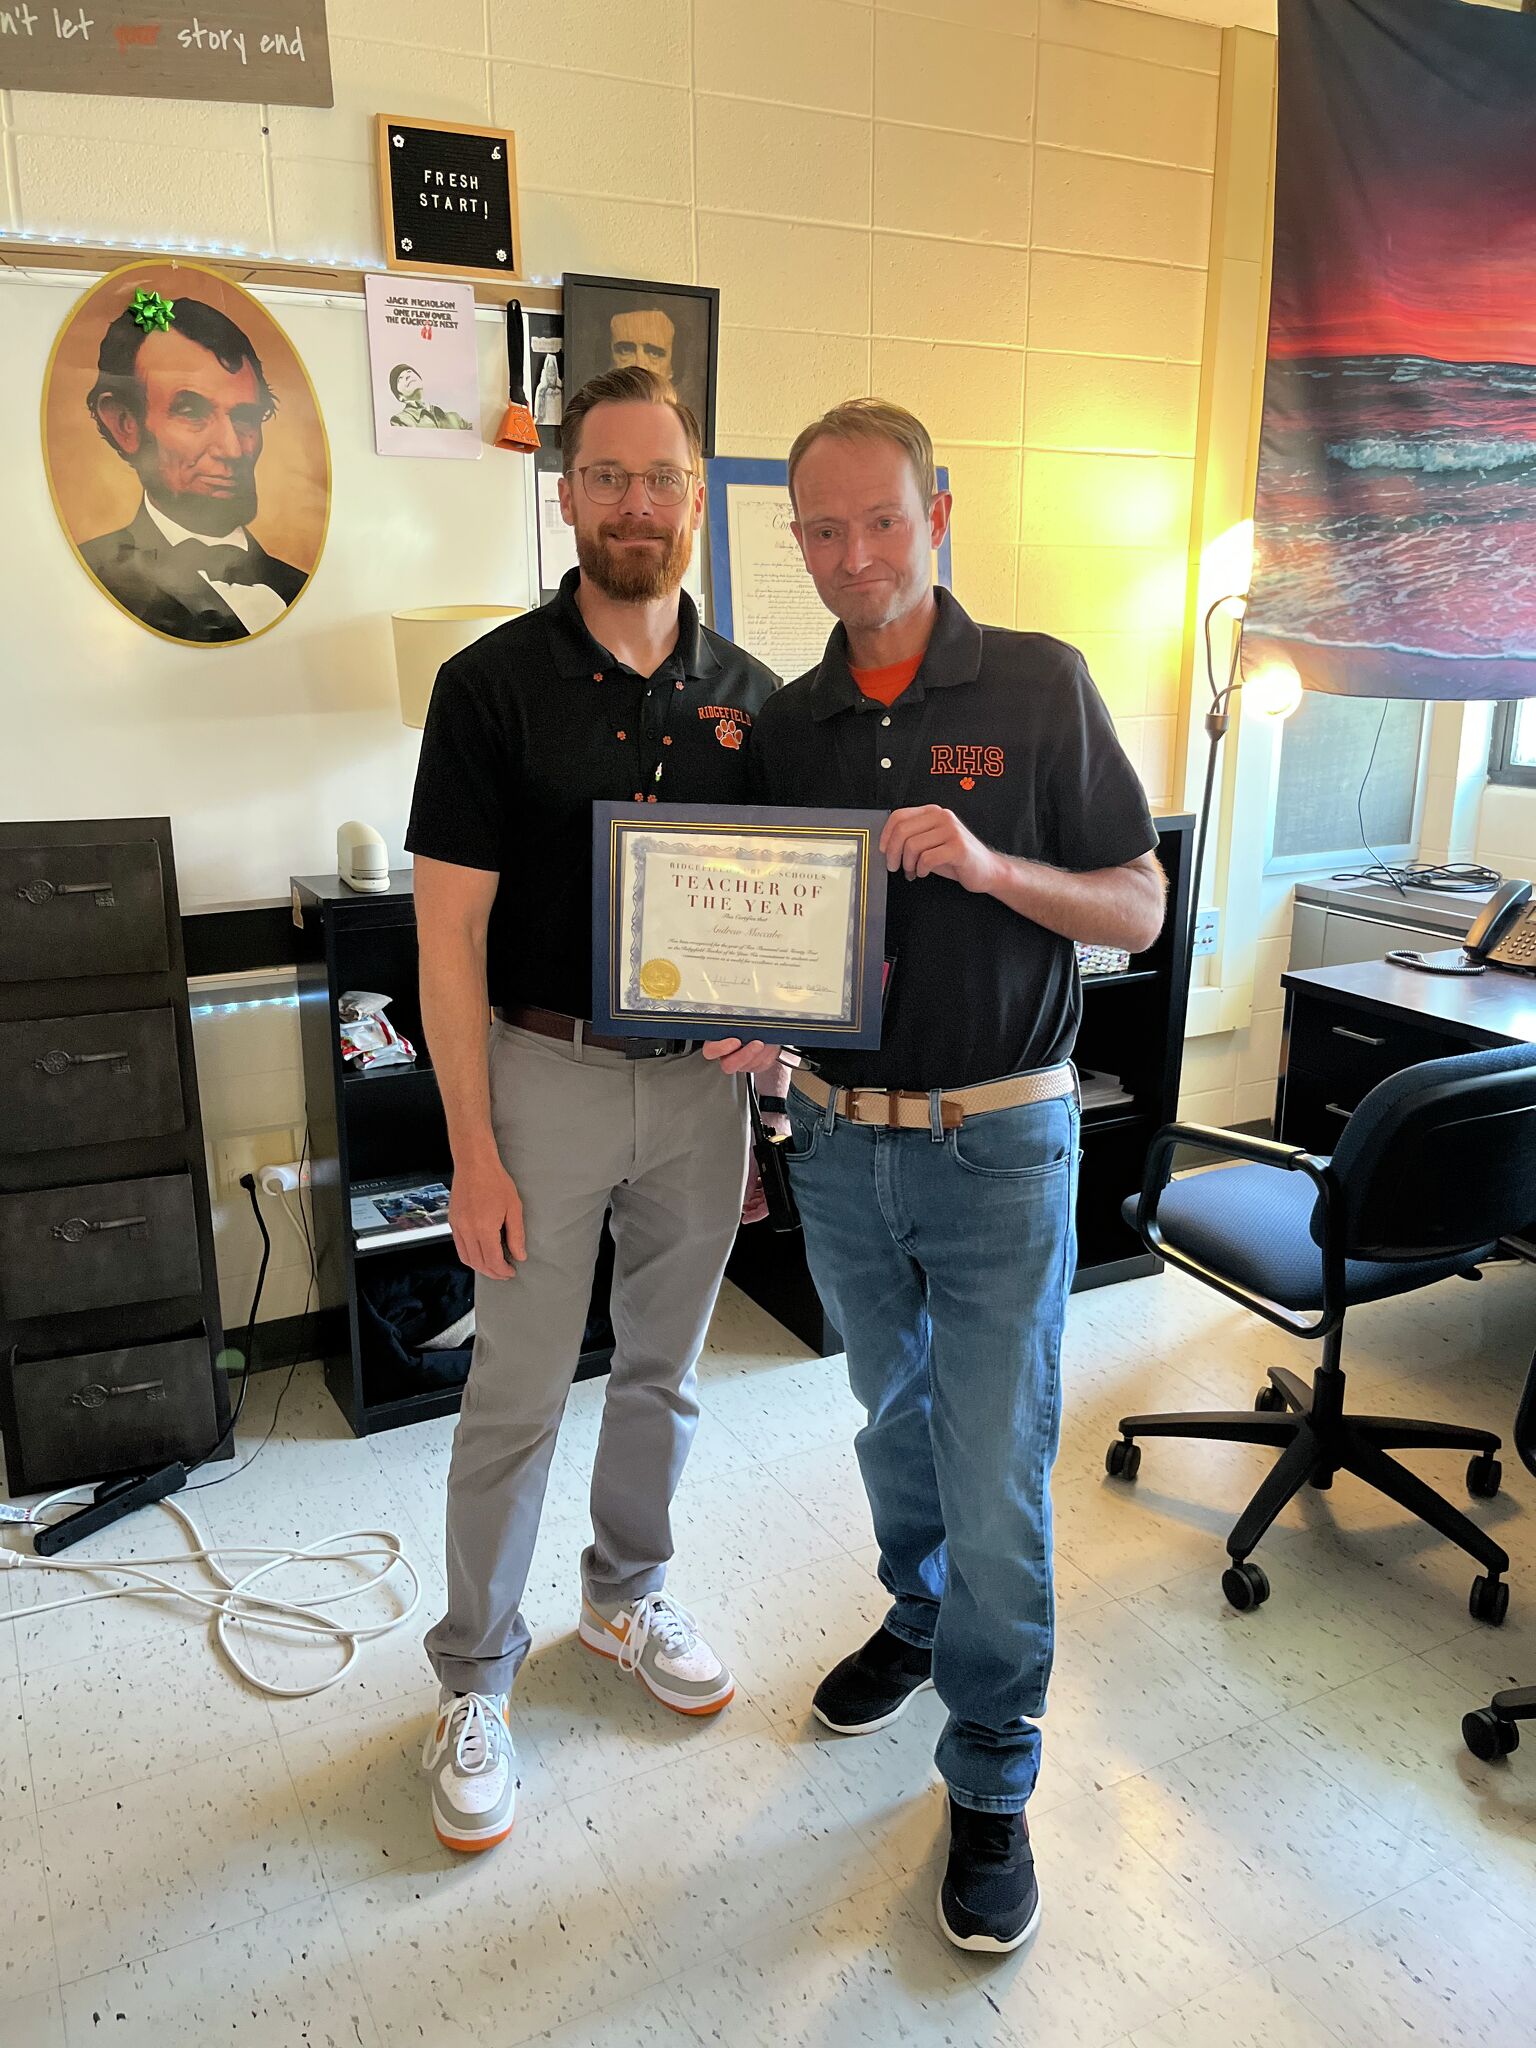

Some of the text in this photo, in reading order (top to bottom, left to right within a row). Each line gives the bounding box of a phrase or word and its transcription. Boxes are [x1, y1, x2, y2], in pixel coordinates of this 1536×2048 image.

[0, 3, 38, 36] n't
[53, 7, 95, 41] let
[177, 17, 247, 65] story
[260, 25, 306, 62] end
[424, 169, 479, 190] FRESH
[419, 193, 489, 220] START!
[386, 296, 456, 310] JACK NICHOLSON
[385, 315, 459, 329] THE CUCKOO'S NEST
[393, 308, 452, 321] ONE FLEW OVER
[697, 705, 752, 727] RIDGEFIELD
[930, 744, 1005, 777] RHS
[779, 871, 827, 880] SCHOOLS
[672, 874, 824, 899] TEACHER OF
[687, 894, 804, 917] THE YEAR
[350, 1180, 388, 1191] uman
